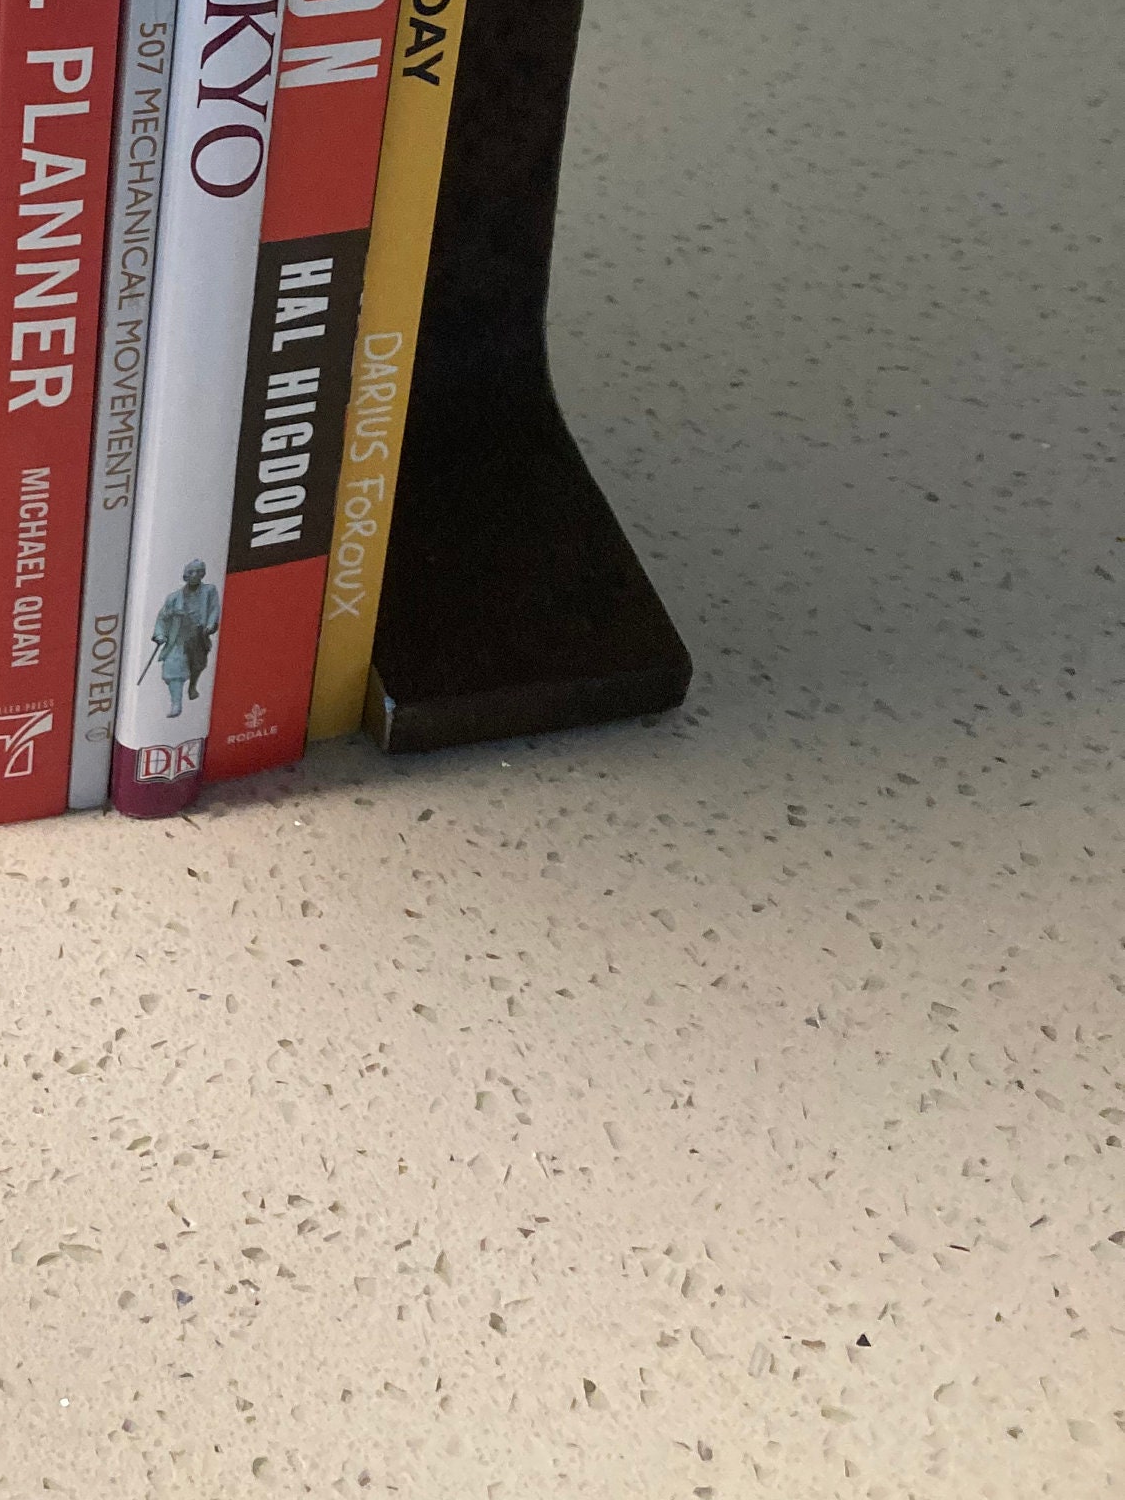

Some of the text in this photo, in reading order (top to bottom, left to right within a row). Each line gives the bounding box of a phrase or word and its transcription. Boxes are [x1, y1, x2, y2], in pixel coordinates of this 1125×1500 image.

[8, 46, 94, 413] PLANNER
[102, 21, 167, 511] 507 MECHANICAL MOVEMENTS
[250, 256, 334, 551] HAL HIGDON
[350, 331, 403, 464] DARIUS
[9, 466, 51, 668] MICHAEL QUAN
[87, 613, 119, 717] DOVER
[227, 725, 278, 745] RODALE
[142, 748, 200, 778] DK
